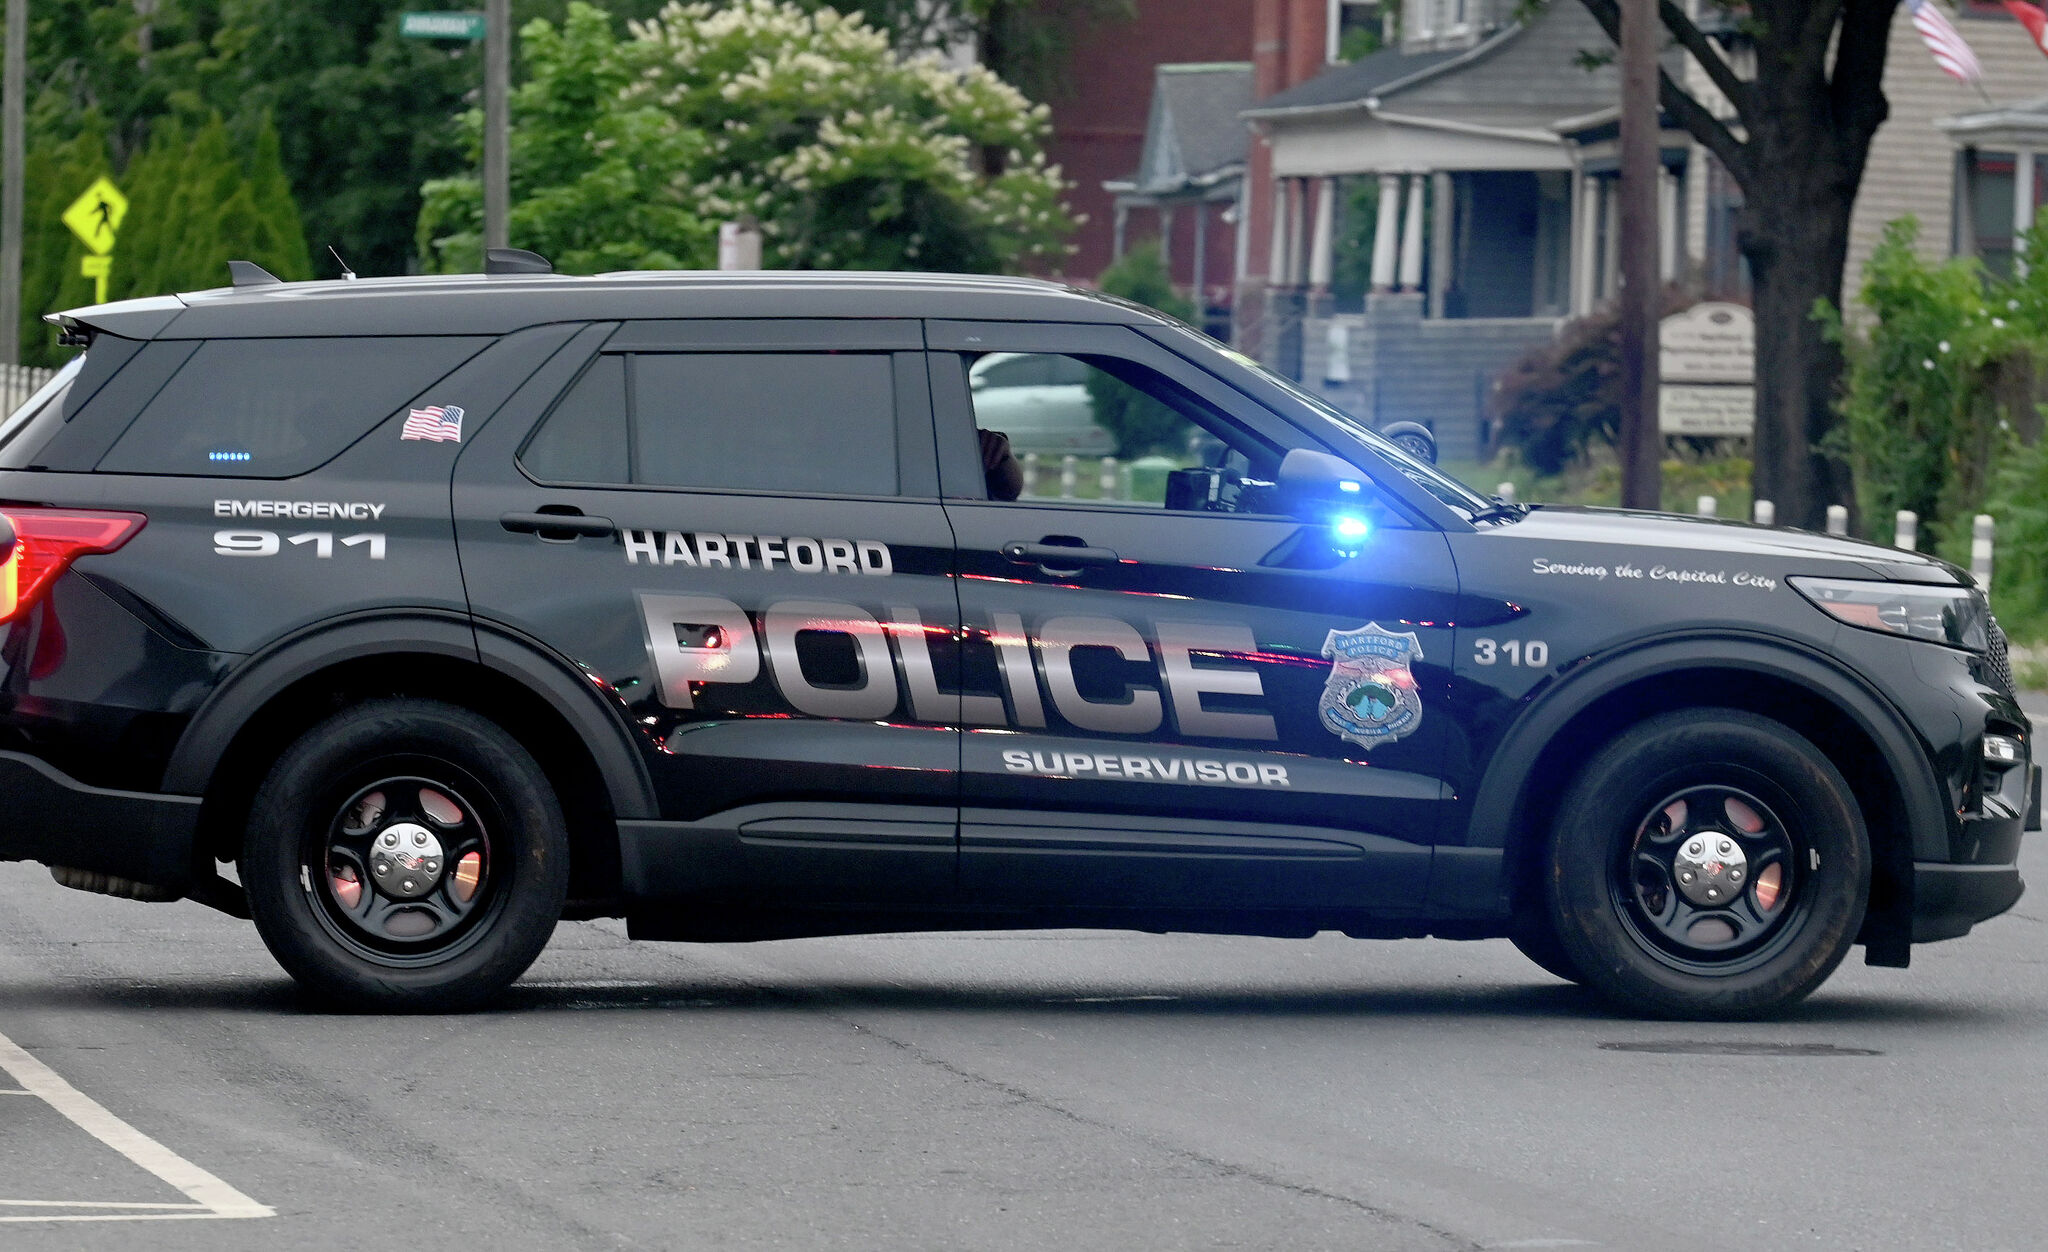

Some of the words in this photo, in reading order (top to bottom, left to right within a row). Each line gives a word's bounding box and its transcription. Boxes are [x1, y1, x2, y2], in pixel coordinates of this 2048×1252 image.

[214, 499, 386, 521] EMERGENCY
[213, 529, 386, 560] 911
[621, 527, 894, 577] HARTFORD
[1532, 557, 1609, 581] Serving
[1614, 562, 1643, 579] the
[1649, 564, 1727, 585] Capital
[1732, 571, 1777, 592] City
[1341, 635, 1403, 650] HARTFORD
[1350, 644, 1393, 656] POLICE
[1472, 637, 1550, 669] 310
[638, 592, 1278, 741] POLICE
[1001, 749, 1290, 788] SUPERVISOR
